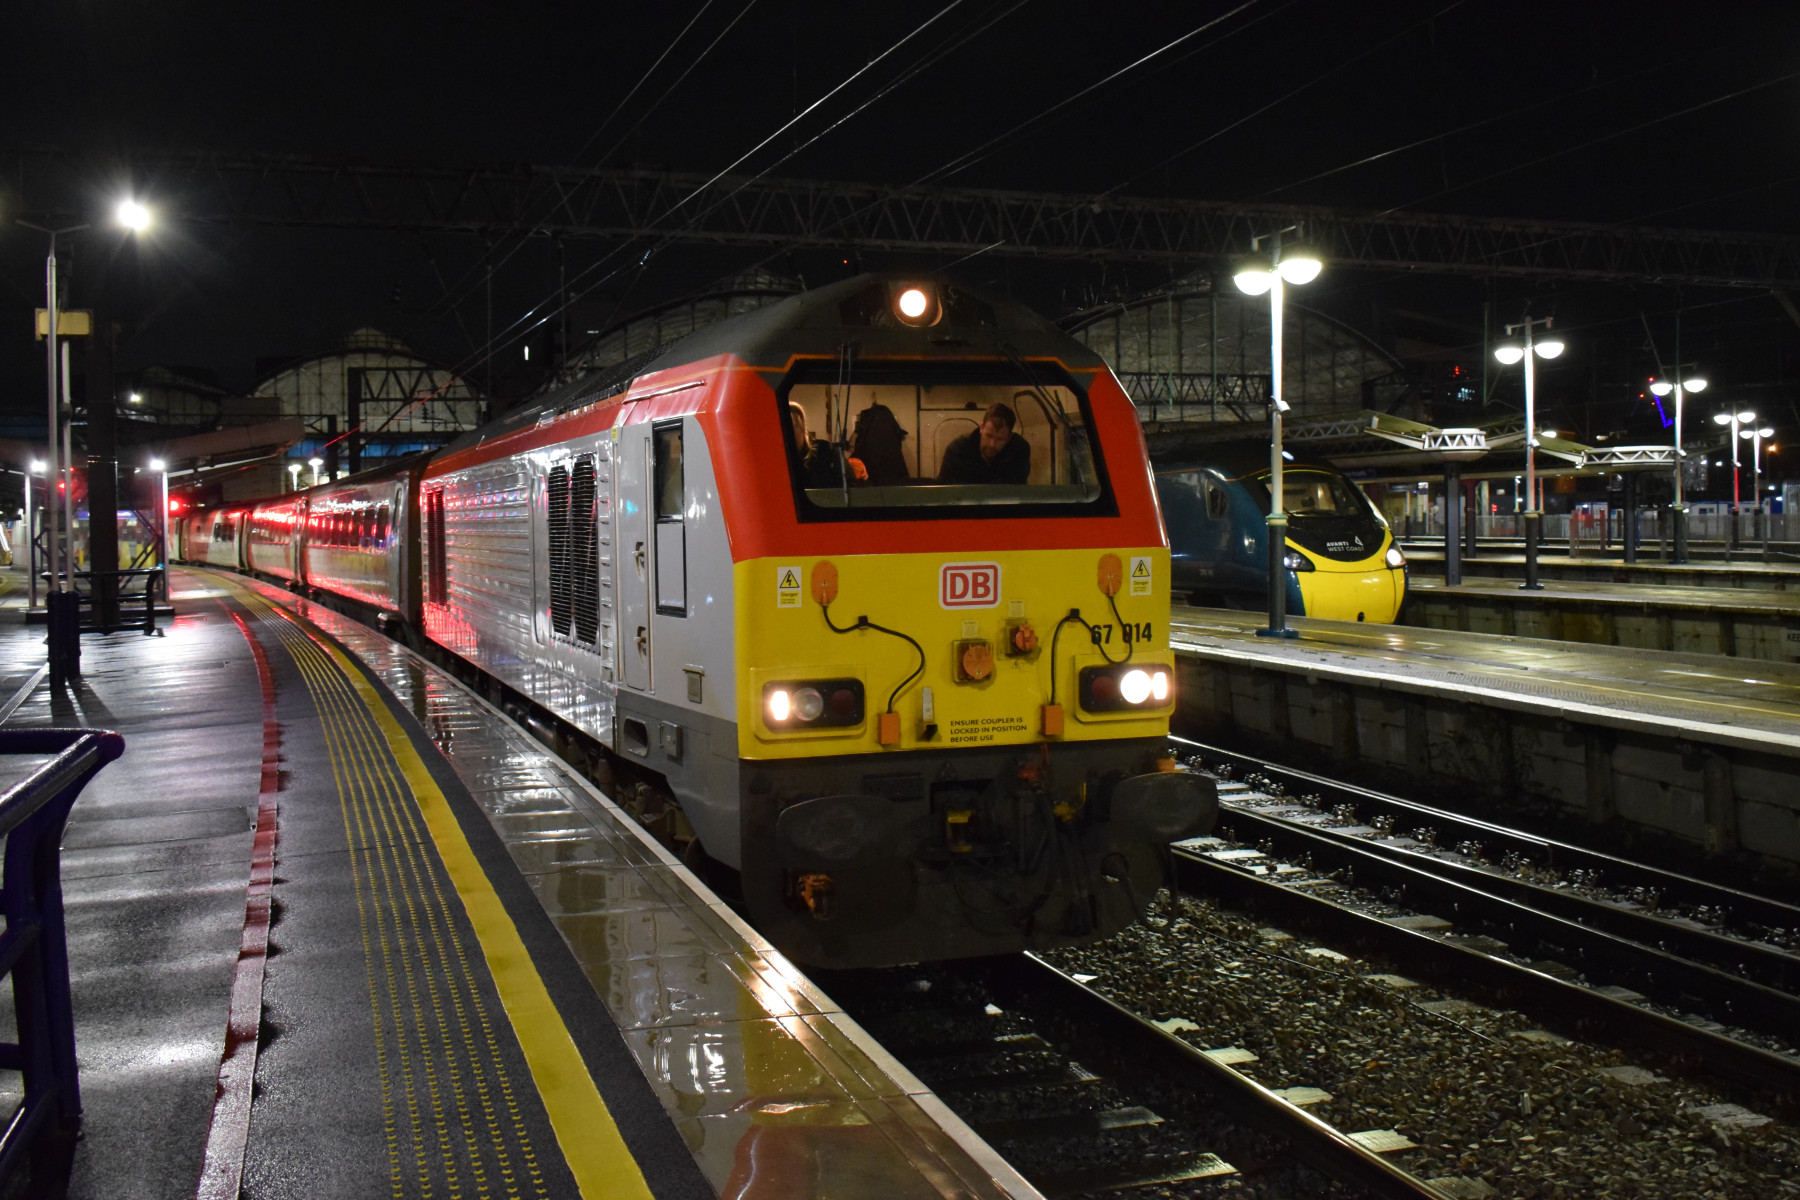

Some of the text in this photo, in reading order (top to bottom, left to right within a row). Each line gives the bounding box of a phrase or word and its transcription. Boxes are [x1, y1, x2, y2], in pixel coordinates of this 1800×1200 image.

[949, 571, 991, 599] DB
[1091, 624, 1113, 645] 67
[981, 717, 1015, 725] COUPLER
[991, 724, 1027, 732] POSITION
[950, 735, 978, 743] BEFORE
